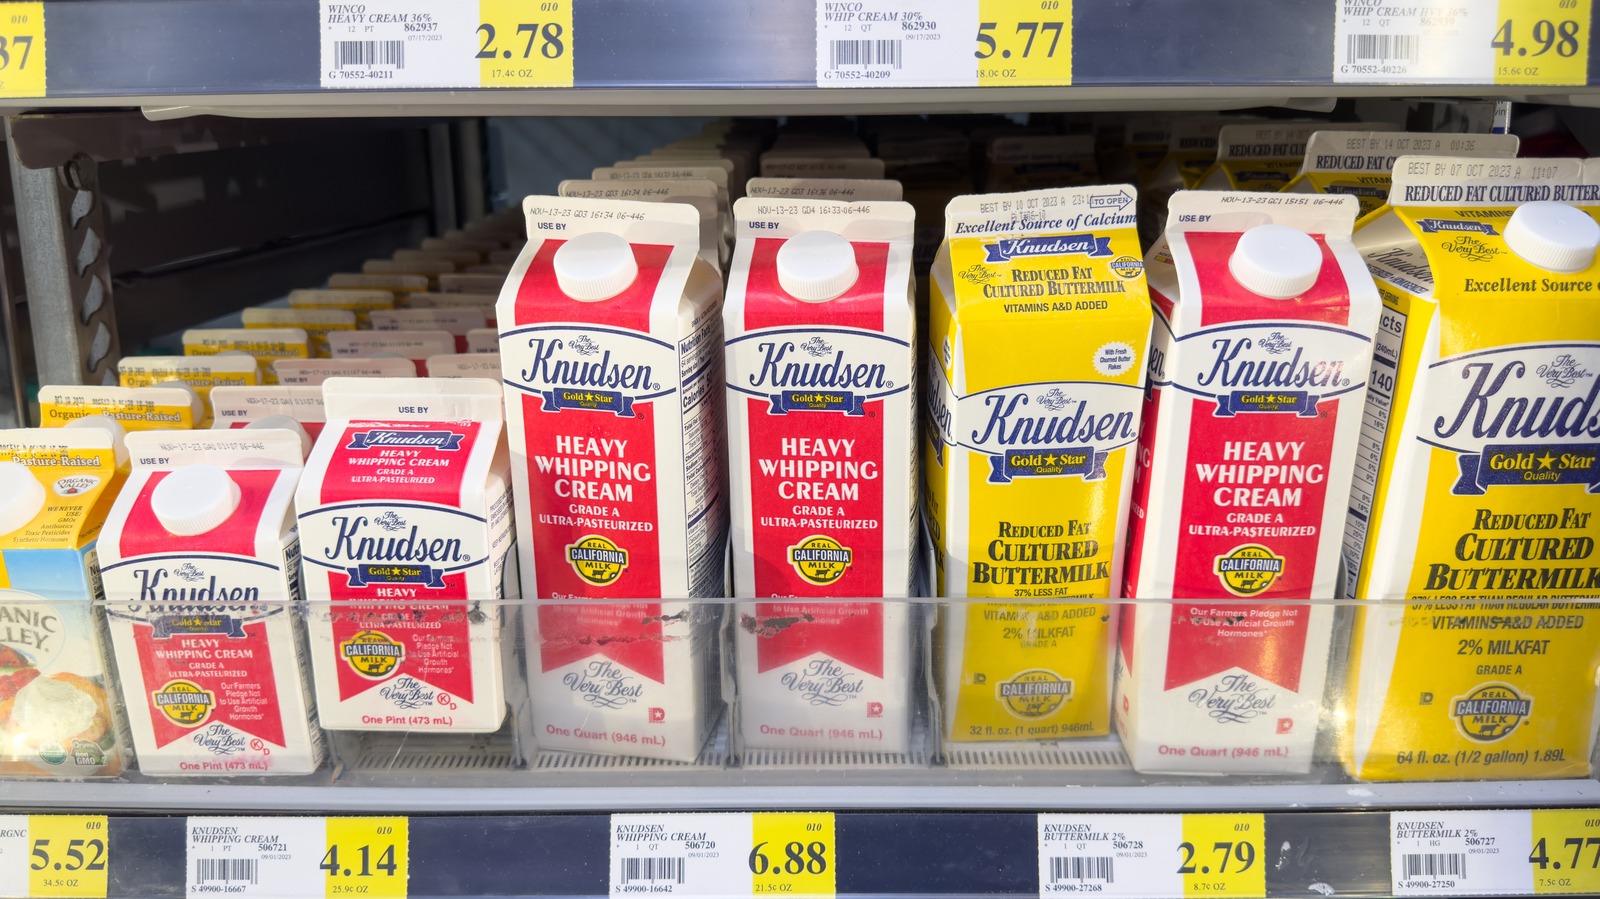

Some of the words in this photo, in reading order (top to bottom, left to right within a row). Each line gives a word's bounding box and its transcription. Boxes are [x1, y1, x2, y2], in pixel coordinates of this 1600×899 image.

[329, 5, 365, 13] WINCO
[541, 3, 558, 11] 010
[1343, 7, 1373, 16] WHIP
[1376, 7, 1416, 16] CREAM
[328, 14, 366, 23] HEAVY
[369, 14, 407, 23] CREAM
[411, 14, 432, 22] 36%
[825, 13, 855, 21] WHIP
[858, 12, 898, 21] CREAM
[901, 12, 922, 20] 30%
[404, 23, 437, 31] 862937
[902, 22, 936, 30] 862930
[475, 23, 564, 59] 2.78
[975, 22, 1064, 58] 5.77
[1491, 20, 1579, 57] 4.98
[519, 70, 532, 78] OZ
[835, 71, 890, 79] 70552-40209
[1352, 66, 1407, 74] 70552-40226
[1524, 67, 1538, 76] OZ
[1408, 162, 1430, 175] BEST
[1435, 163, 1446, 175] BY
[1466, 164, 1484, 177] OCT
[1488, 166, 1511, 178] 2023
[1405, 185, 1463, 201] REDUCED
[1465, 185, 1487, 201] FAT
[1489, 185, 1551, 201] CULTURED
[590, 210, 613, 219] 16:34
[617, 212, 645, 220] 06-446
[956, 220, 1016, 234] Excellent
[1019, 218, 1062, 230] Source
[1067, 214, 1080, 230] of
[1084, 214, 1137, 226] Calcium
[1003, 237, 1089, 254] Knudsen
[1012, 269, 1069, 282] REDUCED
[1071, 267, 1092, 280] FAT
[984, 283, 1044, 298] CULTURED
[1048, 281, 1126, 295] BUTTERMILK
[1464, 278, 1542, 292] Excellent
[1546, 278, 1592, 292] Source
[1004, 303, 1049, 313] VITAMINS
[1052, 302, 1072, 311] A&D
[1077, 301, 1108, 310] ADDED
[522, 339, 652, 391] Knudsen
[750, 342, 885, 388] Knudsen
[1371, 370, 1393, 391] 140
[564, 392, 584, 401] Gold
[595, 394, 613, 403] Star
[972, 393, 1133, 445] Knudsen
[367, 432, 443, 445] Knudsen
[556, 435, 628, 458] HEAVY
[782, 438, 855, 457] HEAVY
[1223, 441, 1305, 461] HEAVY
[12, 456, 101, 466] Pasture-Raised
[349, 458, 405, 466] WHIPPING
[409, 459, 449, 467] CREAM
[1011, 454, 1042, 466] Gold
[1060, 455, 1086, 465] Star
[1490, 453, 1534, 470] Gold
[1558, 453, 1595, 469] Star
[535, 456, 651, 481] WHIPPING
[759, 459, 878, 480] WHIPPING
[1196, 464, 1324, 484] WHIPPING
[1523, 471, 1561, 481] Quality
[555, 479, 633, 502] CREAM
[778, 481, 858, 500] CREAM
[1214, 487, 1302, 507] CREAM
[539, 514, 653, 531] ULTRA-PASTEURIZED
[761, 517, 878, 529] ULTRA-PASTEURIZED
[325, 516, 463, 562] Knudsen
[988, 540, 1098, 562] CULTURED
[1455, 533, 1594, 561] CULTURED
[572, 549, 624, 564] CALIFORNIA
[794, 550, 849, 562] CALIFORNIA
[973, 561, 1109, 585] BUTTERMILK
[1014, 589, 1031, 597] 37%
[1034, 588, 1053, 596] LESS
[1055, 587, 1068, 595] FAT
[1250, 609, 1280, 619] Pledge
[346, 644, 400, 655] CALIFORNIA
[1458, 639, 1483, 655] 2%
[1487, 640, 1550, 655] MILKFAT
[156, 650, 212, 660] WHIPPING
[214, 650, 253, 658] CREAM
[157, 694, 209, 704] CALIFORNIA
[1457, 700, 1526, 715] CALIFORNIA
[362, 716, 383, 724] One
[387, 715, 405, 724] Pint
[409, 716, 430, 725] (473
[433, 716, 452, 726] mL)
[546, 724, 570, 736] One
[574, 728, 607, 740] Quart
[1158, 745, 1185, 755] One
[1190, 746, 1227, 757] Quart
[1484, 751, 1528, 765] gallon)
[1534, 750, 1565, 762] 1.89L
[1044, 824, 1092, 832] KNUDSEN
[1397, 830, 1461, 838] BUTTERMILK
[192, 835, 242, 843] WHIPPING
[244, 835, 279, 843] CREAM
[617, 833, 668, 841] WHIPPING
[1465, 838, 1495, 846] 506727
[685, 841, 715, 849] 506720
[1113, 841, 1143, 849] 506728
[31, 839, 106, 870] 5.52
[320, 844, 397, 876] 4.14
[749, 841, 827, 875] 6.88
[1176, 841, 1255, 873] 2.79
